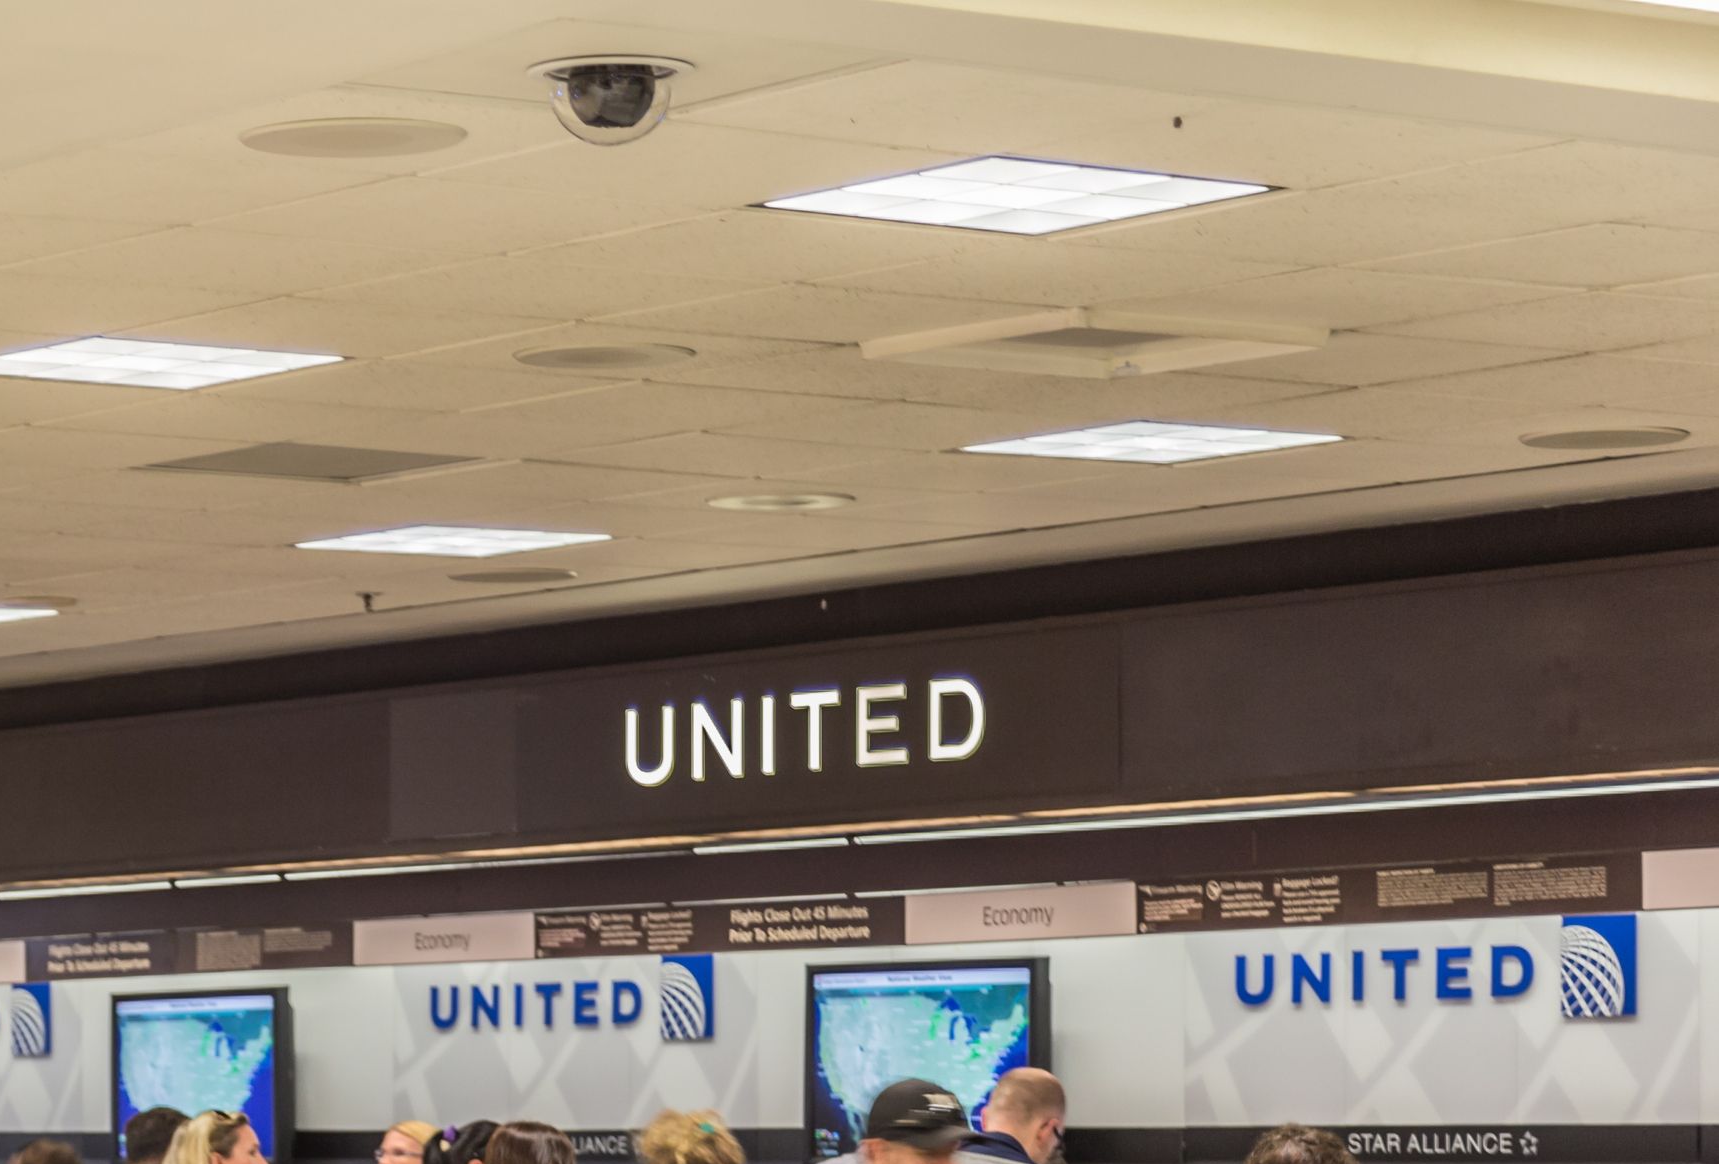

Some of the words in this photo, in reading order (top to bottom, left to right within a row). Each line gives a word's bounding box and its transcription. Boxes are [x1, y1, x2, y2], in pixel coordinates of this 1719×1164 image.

[624, 677, 985, 787] UNITED
[730, 907, 763, 927] Flights
[764, 907, 791, 923] Close
[792, 906, 812, 921] Out
[813, 905, 826, 921] 45
[827, 904, 869, 919] Minutes
[982, 901, 1054, 927] Economy
[414, 931, 471, 952] Economy
[729, 927, 753, 943] Prior
[753, 926, 767, 943] To
[767, 925, 818, 942] Scheduled
[819, 924, 871, 942] Departure
[1235, 945, 1534, 1005] UNITED
[429, 979, 644, 1031] UNITED
[571, 1135, 629, 1156] LIANCE
[1348, 1132, 1401, 1155] STAR
[1407, 1131, 1513, 1155] ALLIANCE
